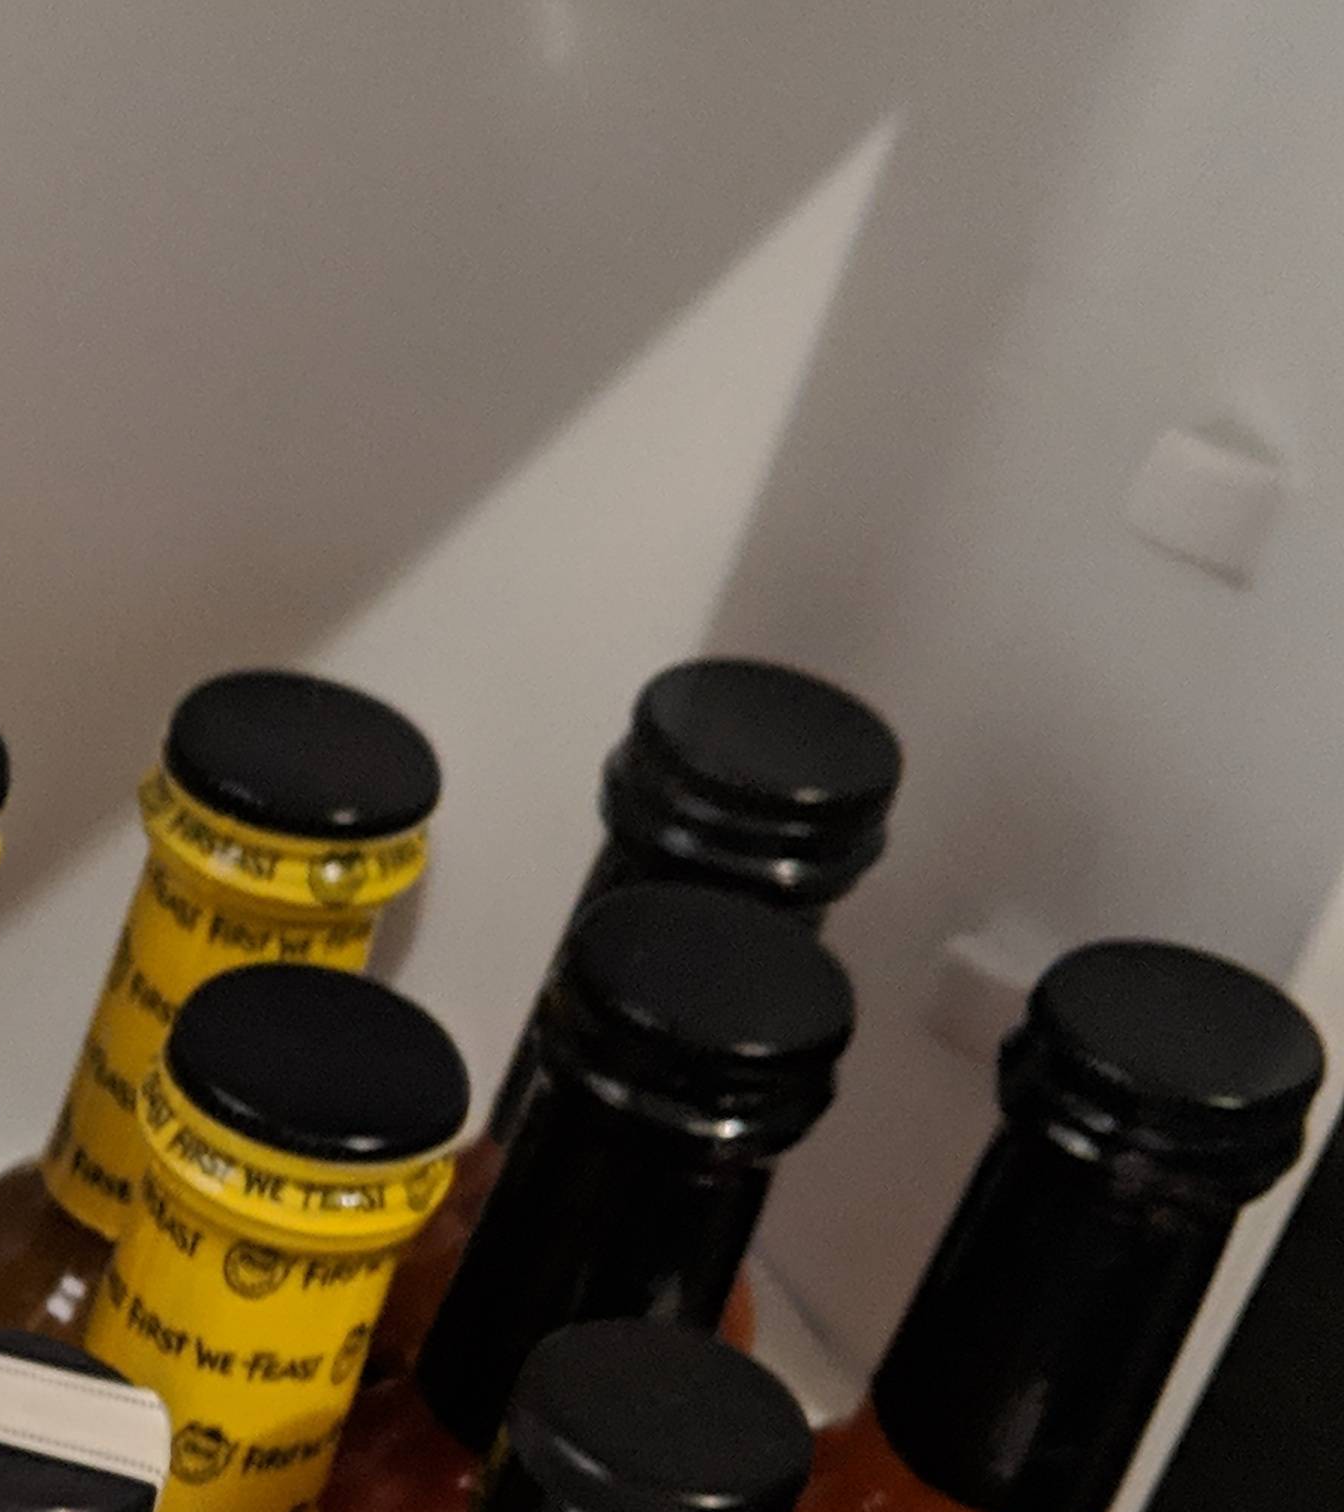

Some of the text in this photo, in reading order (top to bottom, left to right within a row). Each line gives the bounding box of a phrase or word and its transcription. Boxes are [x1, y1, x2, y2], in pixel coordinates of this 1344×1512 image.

[243, 1167, 289, 1203] WE
[126, 1297, 325, 1384] FIRST WE FEAST
